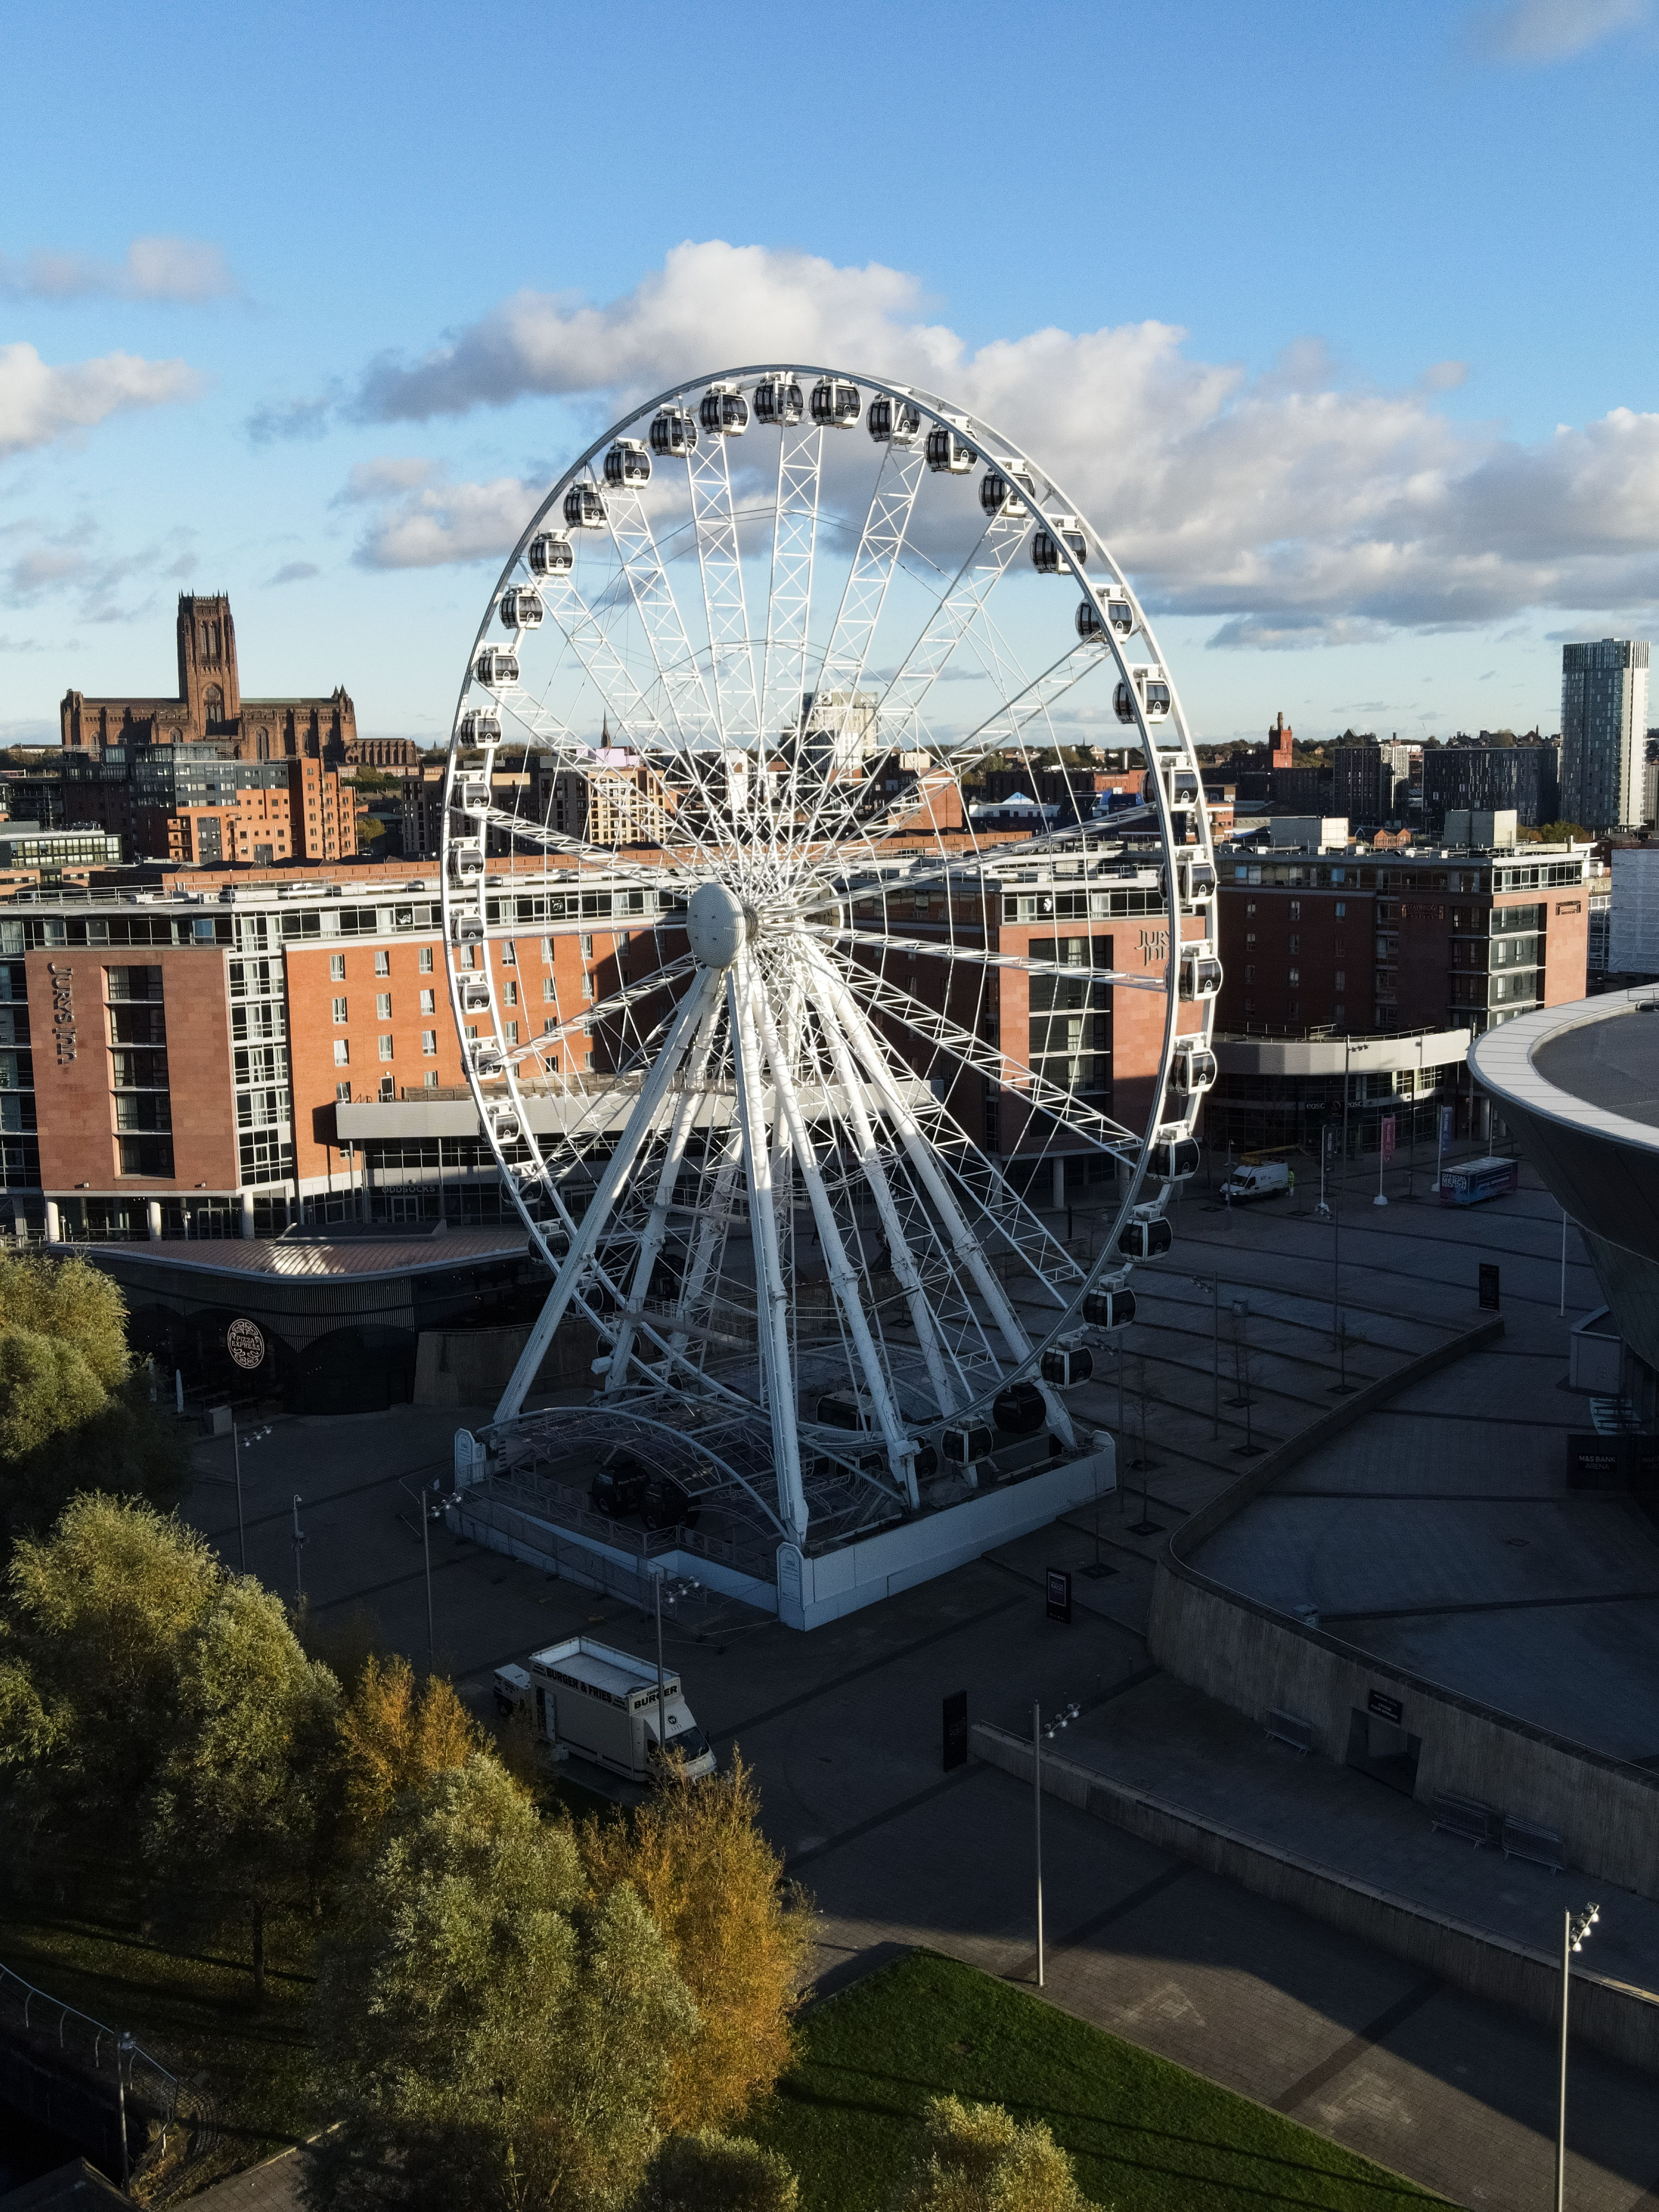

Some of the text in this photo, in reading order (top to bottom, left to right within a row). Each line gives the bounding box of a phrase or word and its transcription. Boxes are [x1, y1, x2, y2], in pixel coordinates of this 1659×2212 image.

[236, 1335, 255, 1343] PIZZA
[232, 1340, 260, 1350] EXPRESS
[547, 1667, 579, 1690] BURGER
[580, 1681, 587, 1693] &
[589, 1685, 612, 1703] FRIES
